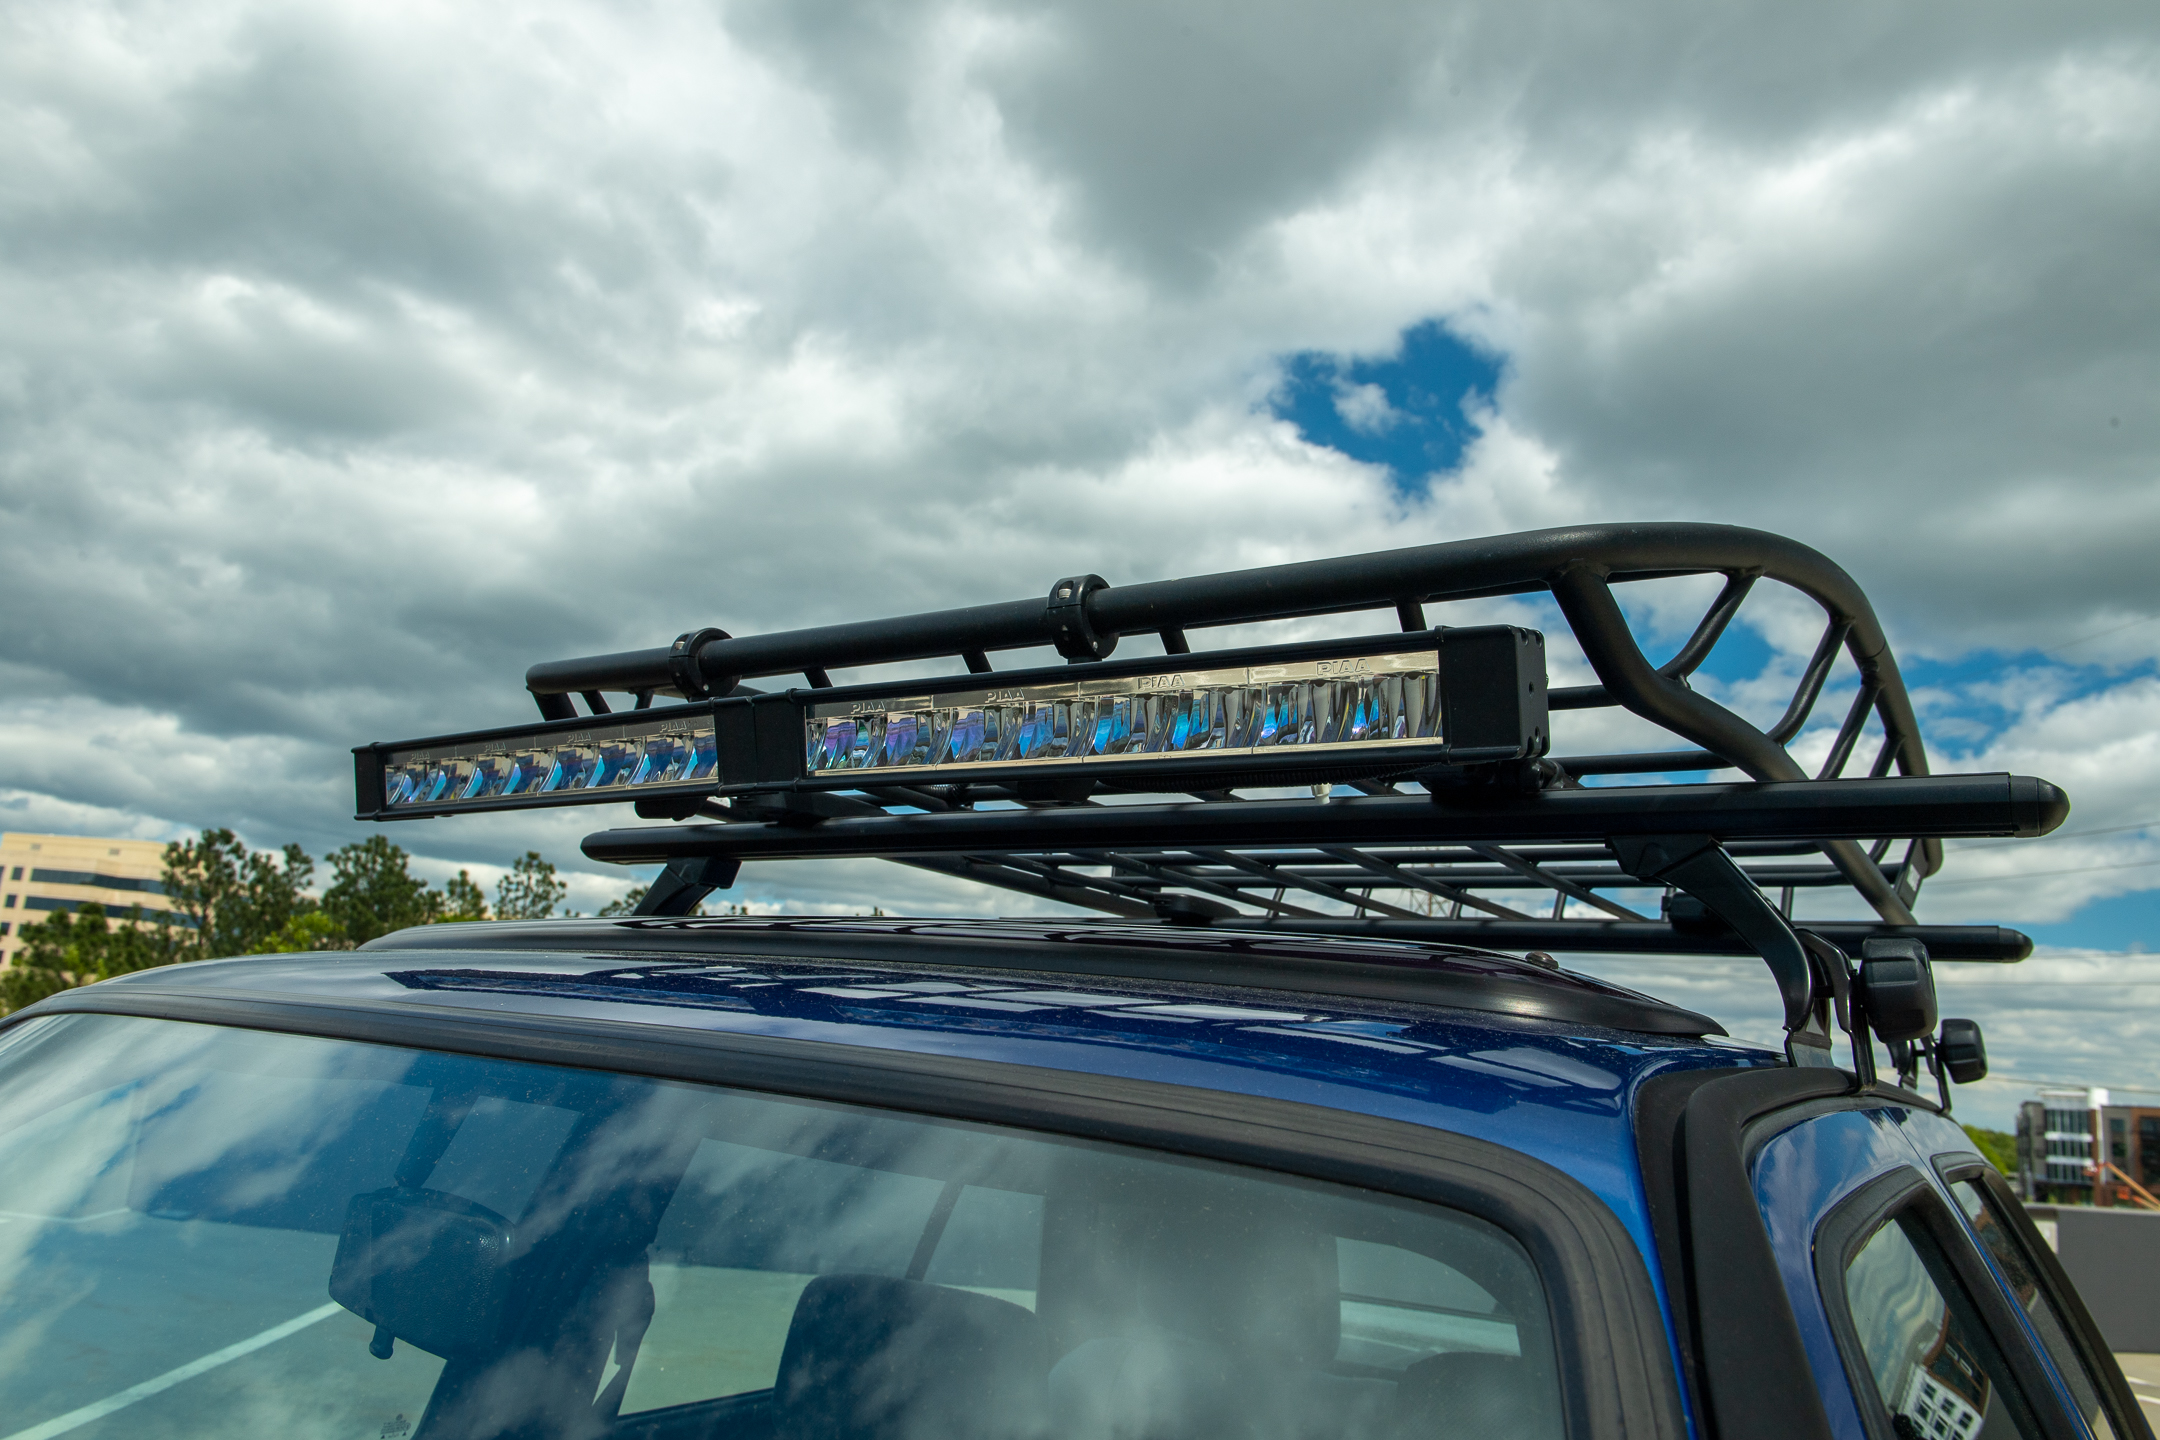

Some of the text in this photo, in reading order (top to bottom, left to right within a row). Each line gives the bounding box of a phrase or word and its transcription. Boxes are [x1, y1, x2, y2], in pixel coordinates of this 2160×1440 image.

[1316, 658, 1371, 676] PIAA
[1137, 674, 1185, 691] PIAA
[984, 688, 1026, 704] PIAA
[850, 700, 886, 715] PIAA
[659, 720, 688, 734] PIAA
[566, 732, 591, 744] PIAA
[484, 742, 506, 753] PIAA
[410, 750, 431, 762] PIAA
